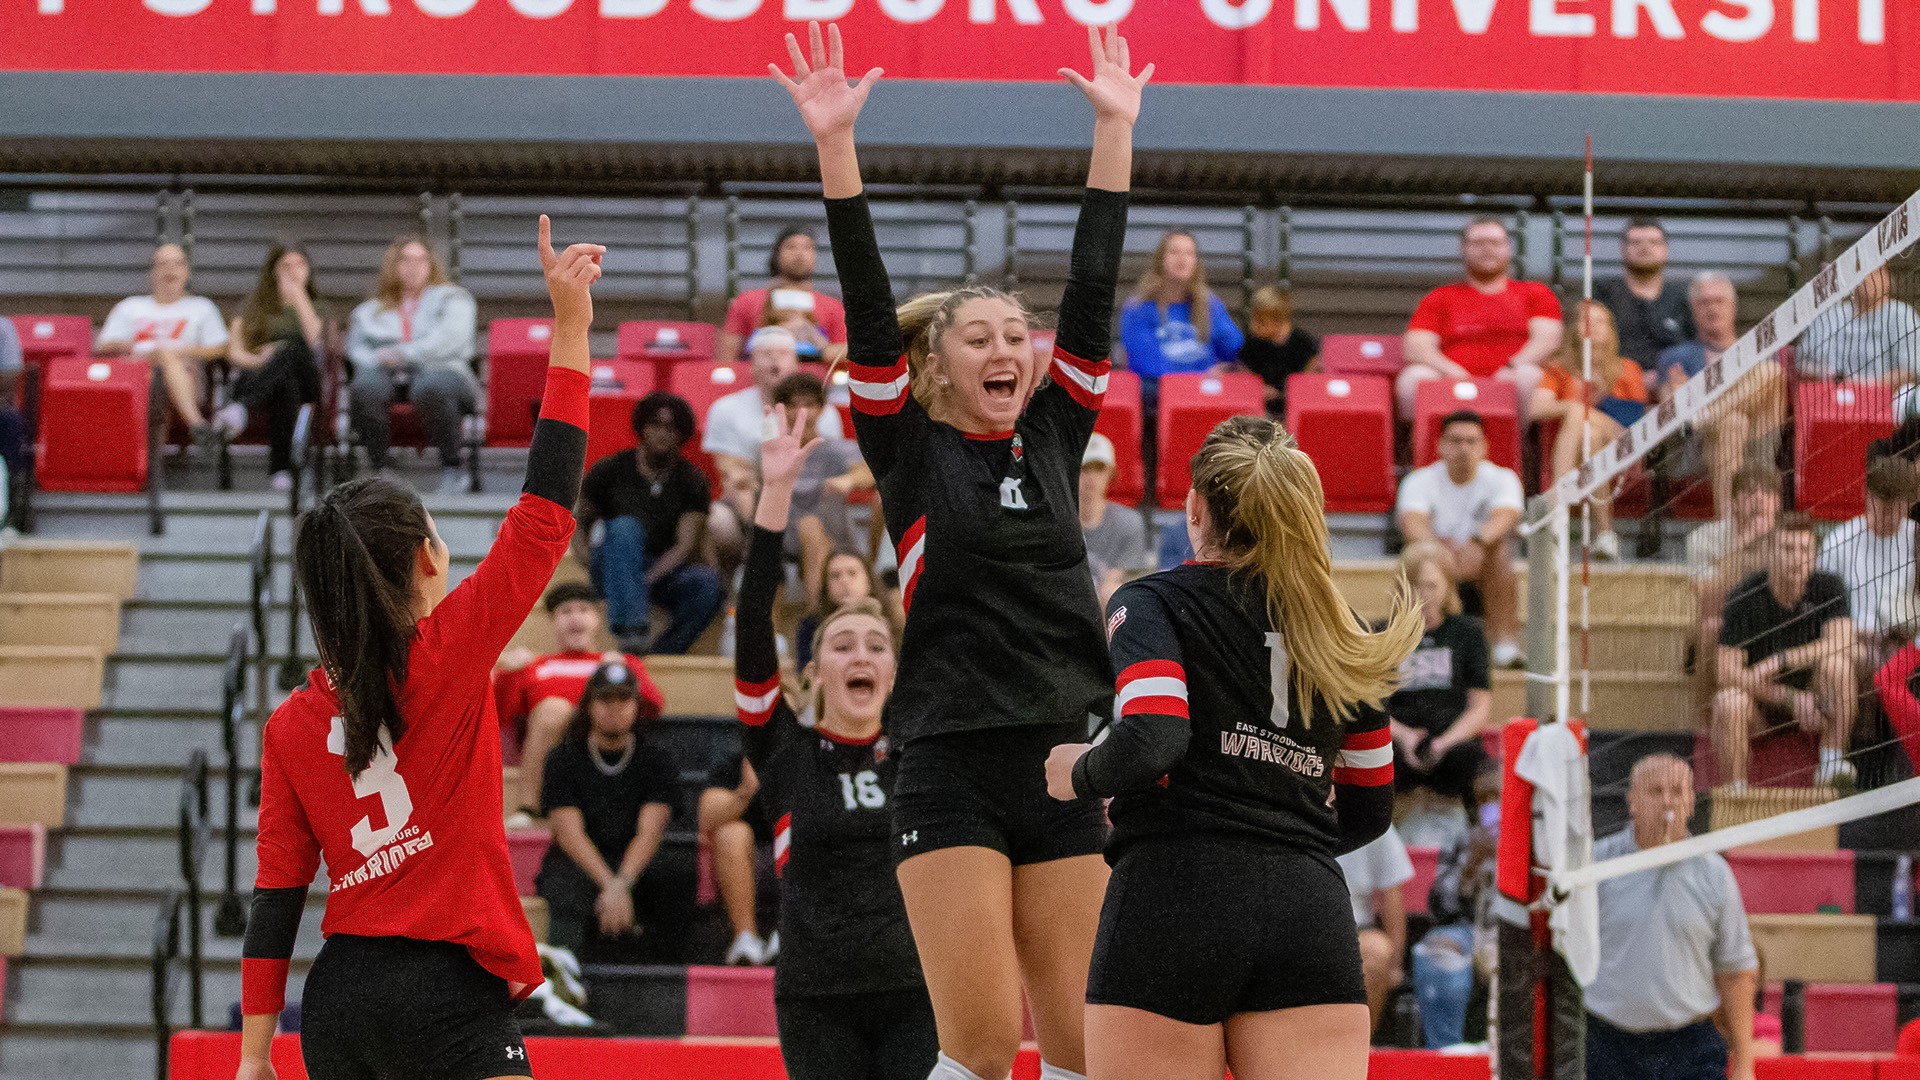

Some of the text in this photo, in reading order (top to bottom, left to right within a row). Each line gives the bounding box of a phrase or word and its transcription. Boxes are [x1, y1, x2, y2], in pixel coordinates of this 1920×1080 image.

[1221, 730, 1325, 777] WARRIORS
[1235, 721, 1316, 755] EAST STROUDURG
[326, 716, 414, 858] 3
[838, 769, 886, 811] 16
